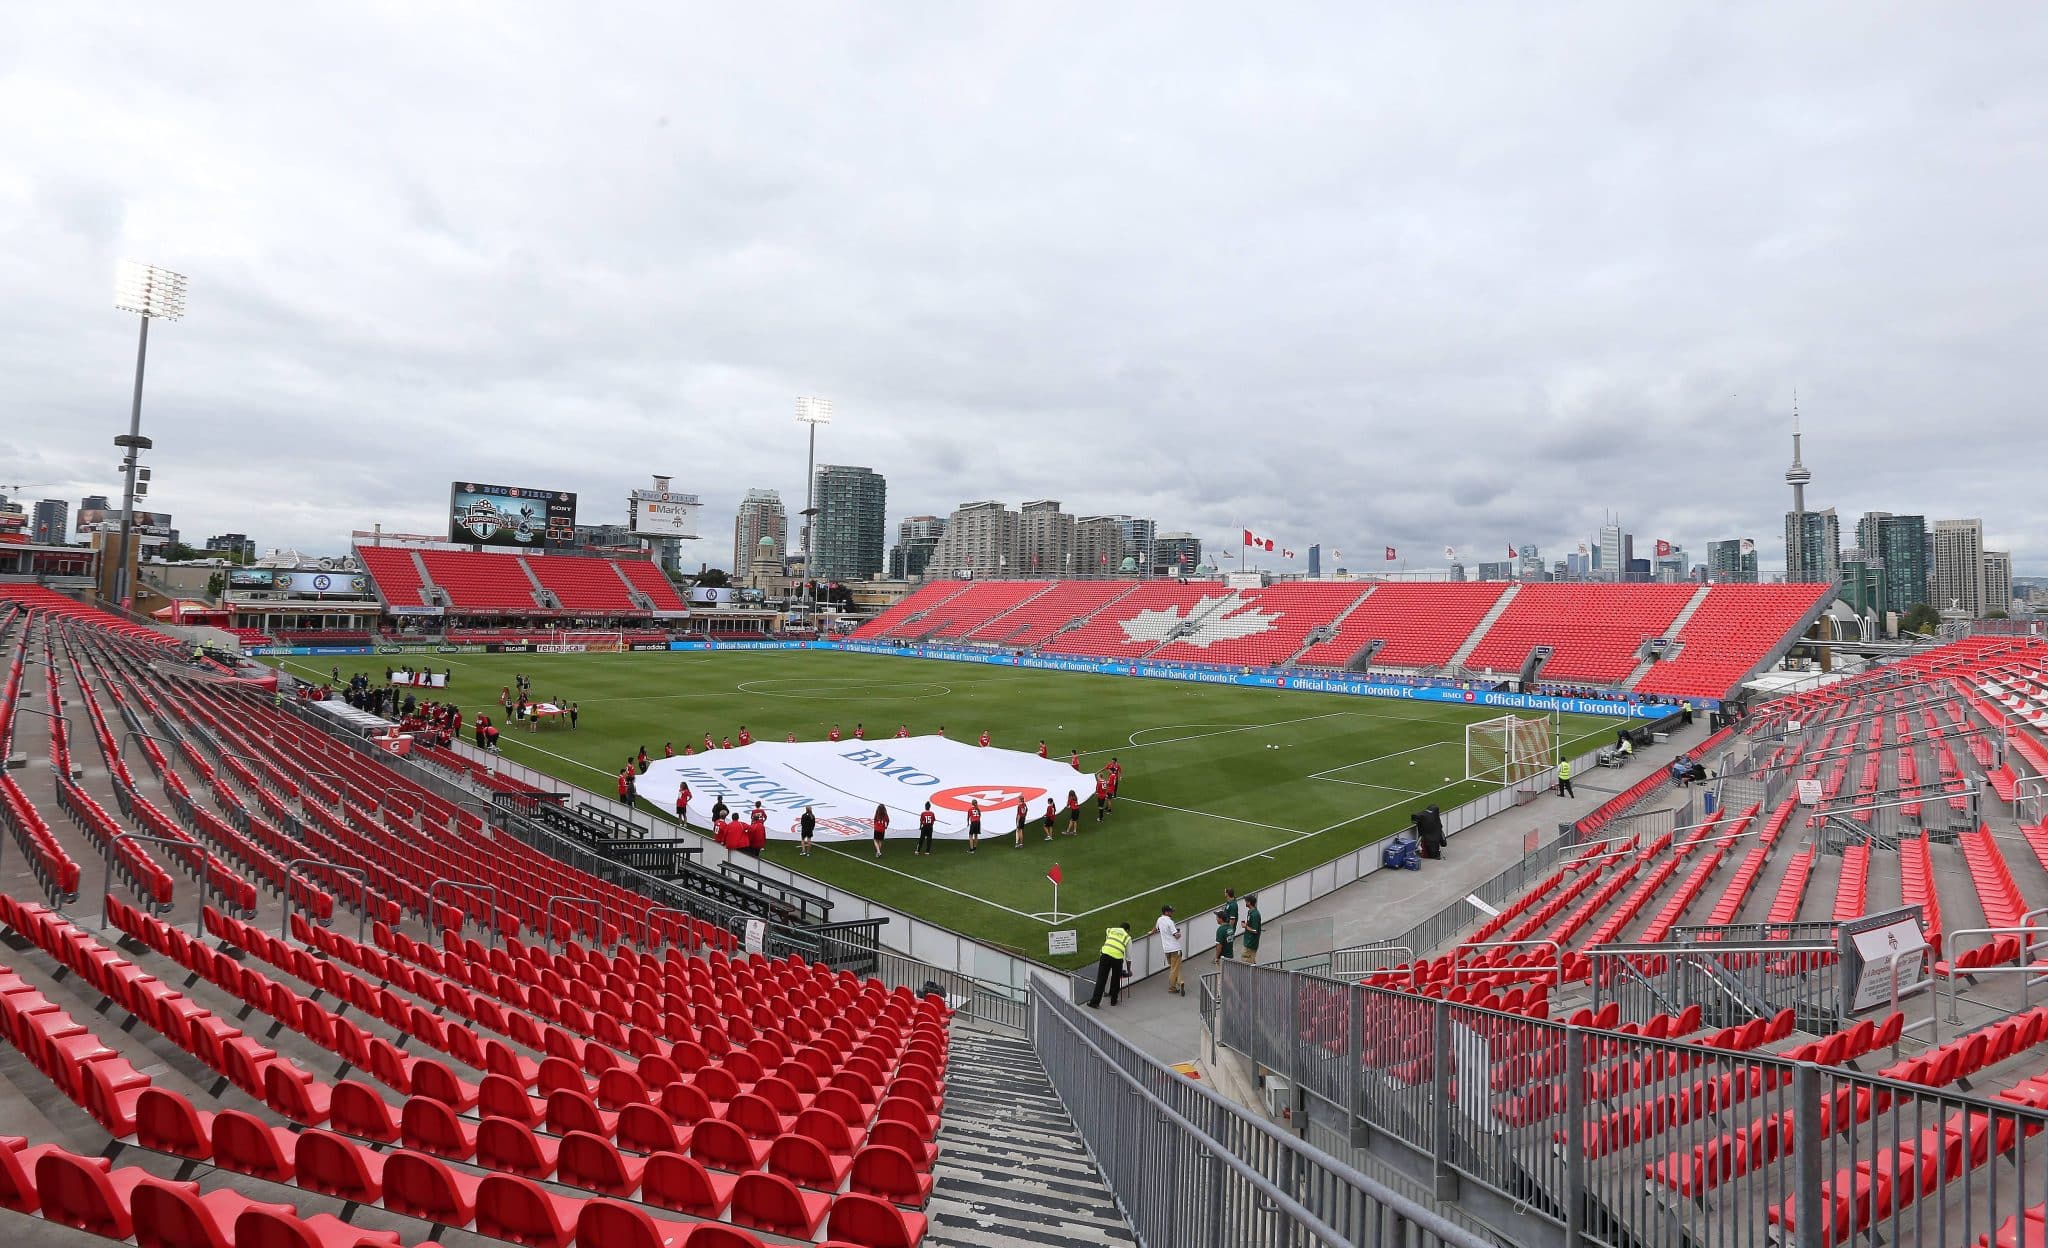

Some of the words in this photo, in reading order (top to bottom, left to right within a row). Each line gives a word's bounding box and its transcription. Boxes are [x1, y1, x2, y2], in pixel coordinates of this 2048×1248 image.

[483, 486, 508, 495] BMO
[521, 490, 553, 499] FIELD
[656, 504, 687, 516] Mark's
[469, 516, 500, 525] TORONTO
[716, 642, 736, 650] Official
[1023, 659, 1043, 667] Official
[1044, 661, 1059, 669] bank
[1060, 661, 1067, 670] of
[1067, 662, 1091, 672] Toronto
[1092, 664, 1100, 672] FC
[1143, 667, 1167, 677] Official
[1168, 668, 1187, 680] bank
[1189, 669, 1197, 681] of
[1198, 672, 1227, 683] Toronto
[1229, 674, 1238, 684] FC
[1293, 679, 1323, 691] Official
[1325, 680, 1349, 693] bank
[1351, 682, 1361, 694] of
[1364, 684, 1400, 697] Toronto
[1402, 687, 1414, 698] FC
[1485, 693, 1525, 707] Official
[1528, 695, 1558, 710] bank
[1561, 700, 1575, 711] of
[1578, 701, 1626, 715] Toronto
[1630, 705, 1645, 717] FC
[390, 741, 400, 753] G
[838, 748, 941, 786] BMO
[675, 767, 741, 797] WITH
[714, 766, 836, 810] KICKIN'
[924, 815, 932, 824] 15
